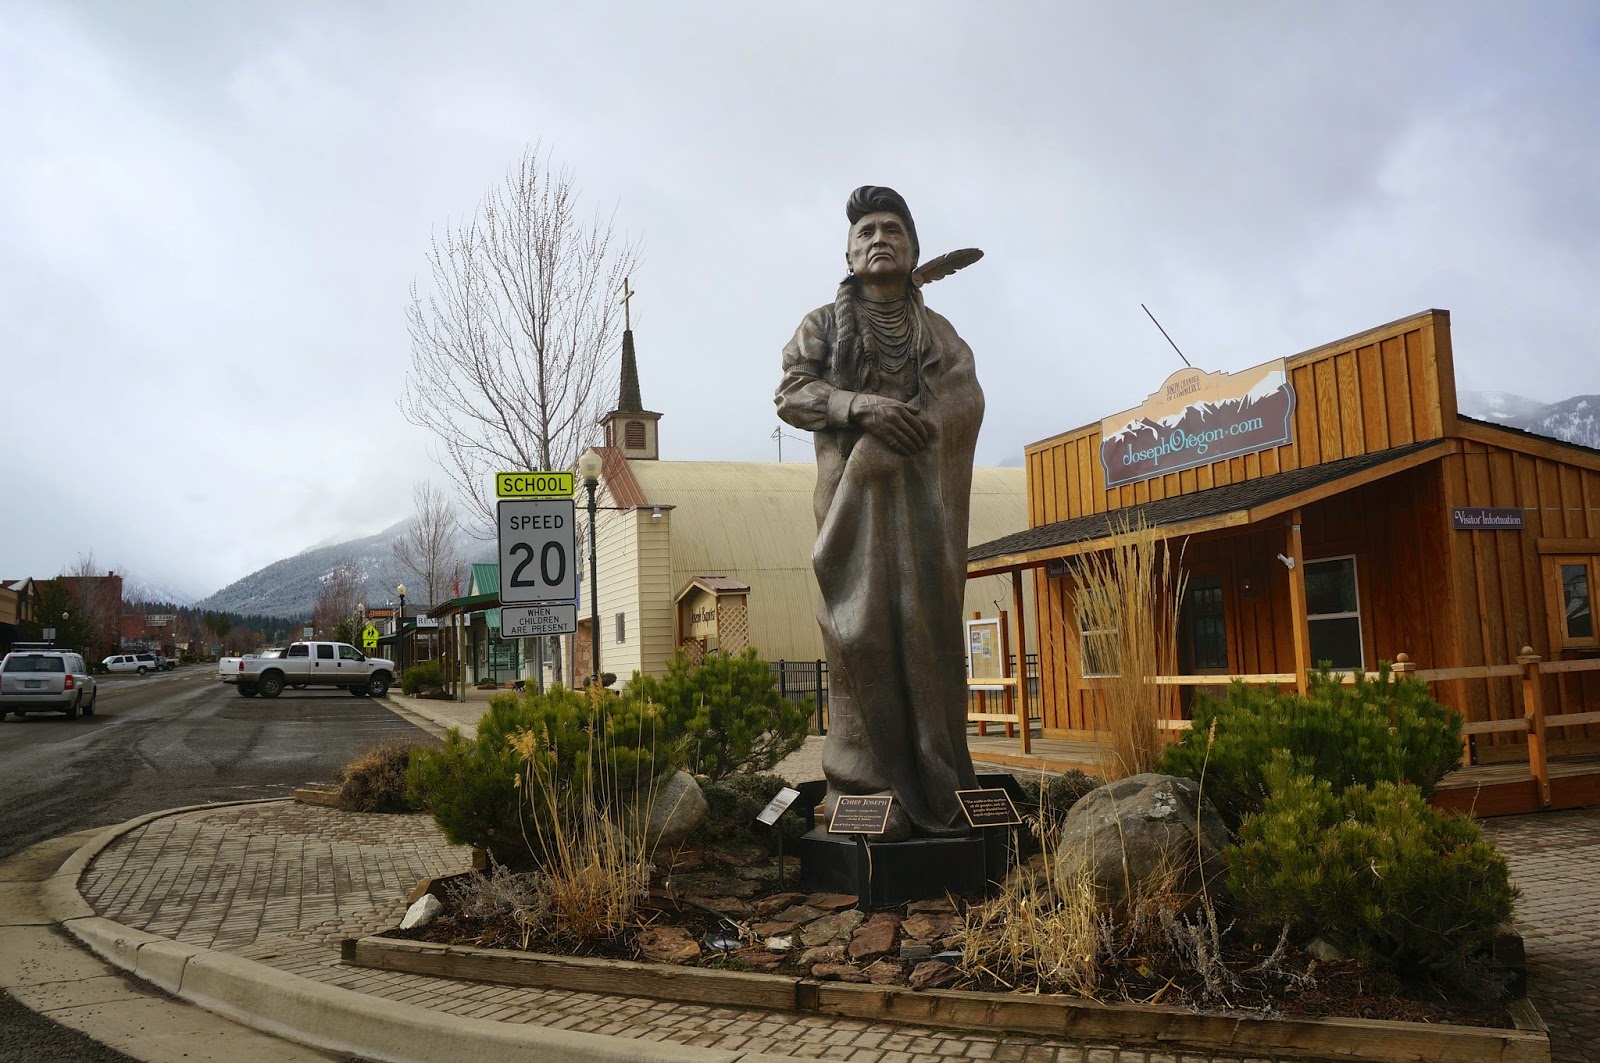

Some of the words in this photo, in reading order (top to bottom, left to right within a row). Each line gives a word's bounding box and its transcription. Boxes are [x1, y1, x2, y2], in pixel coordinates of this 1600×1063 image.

[503, 477, 567, 492] SCHOOL
[510, 515, 564, 530] SPEED
[1454, 510, 1482, 525] Visitor
[1482, 510, 1521, 525] Information
[509, 540, 566, 588] 20
[527, 607, 551, 617] WHEN
[519, 615, 560, 626] CHILDREN
[511, 625, 528, 635] ARE
[531, 623, 568, 633] PRESENT
[841, 798, 862, 806] CHIEF
[862, 798, 888, 807] JOSEPH
